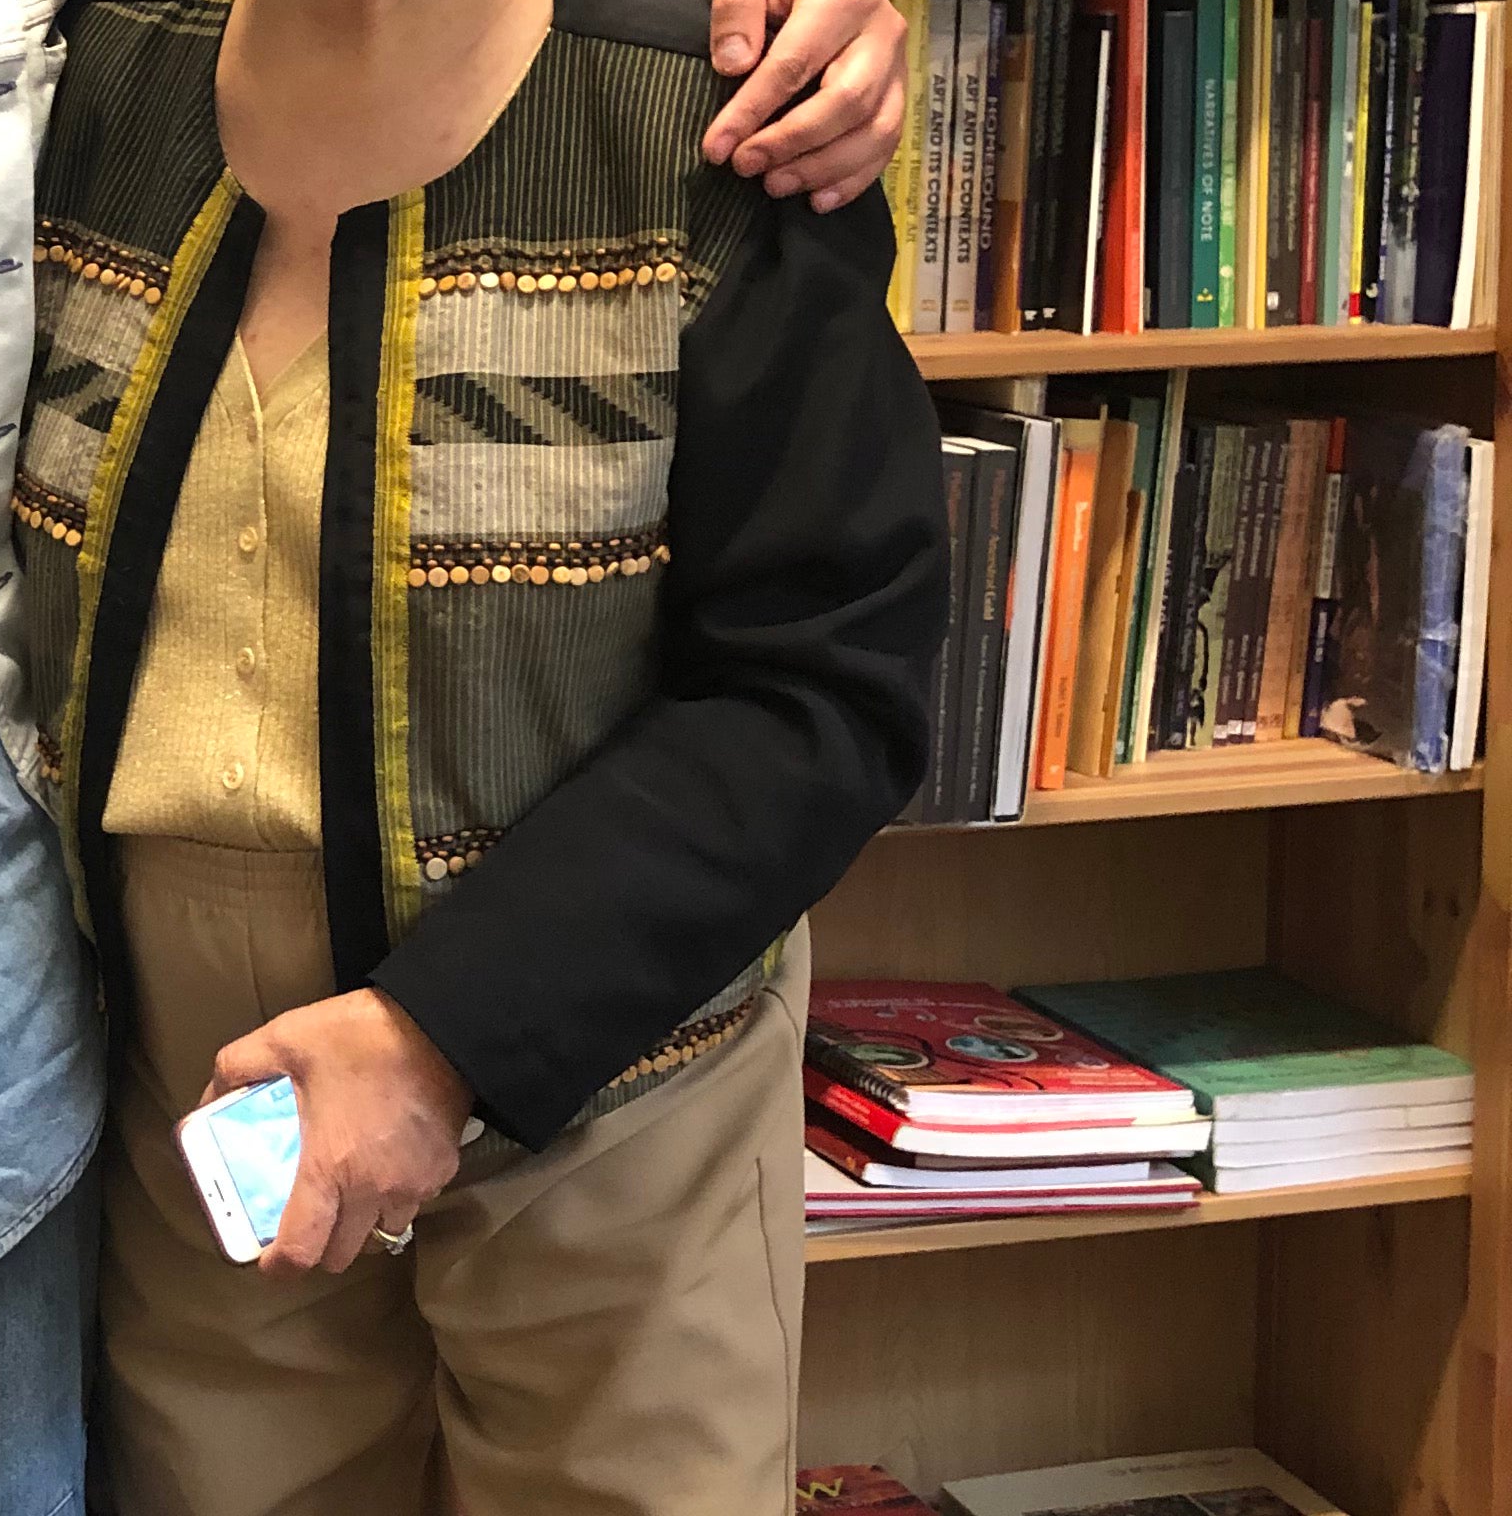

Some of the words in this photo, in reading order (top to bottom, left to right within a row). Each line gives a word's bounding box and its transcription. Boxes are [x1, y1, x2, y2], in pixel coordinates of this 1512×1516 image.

[932, 74, 946, 103] ART
[964, 74, 978, 102] ART
[928, 108, 944, 149] AND
[962, 109, 977, 148] AND
[1202, 79, 1216, 169] NARRATIVES
[927, 151, 942, 175] ITS
[961, 151, 975, 175] ITS
[980, 95, 998, 250] HOMEBOUND
[1202, 175, 1214, 195] OF
[924, 180, 941, 264] CONTEXTS
[957, 180, 975, 264] CONTEXTS
[1201, 202, 1213, 242] NOTE
